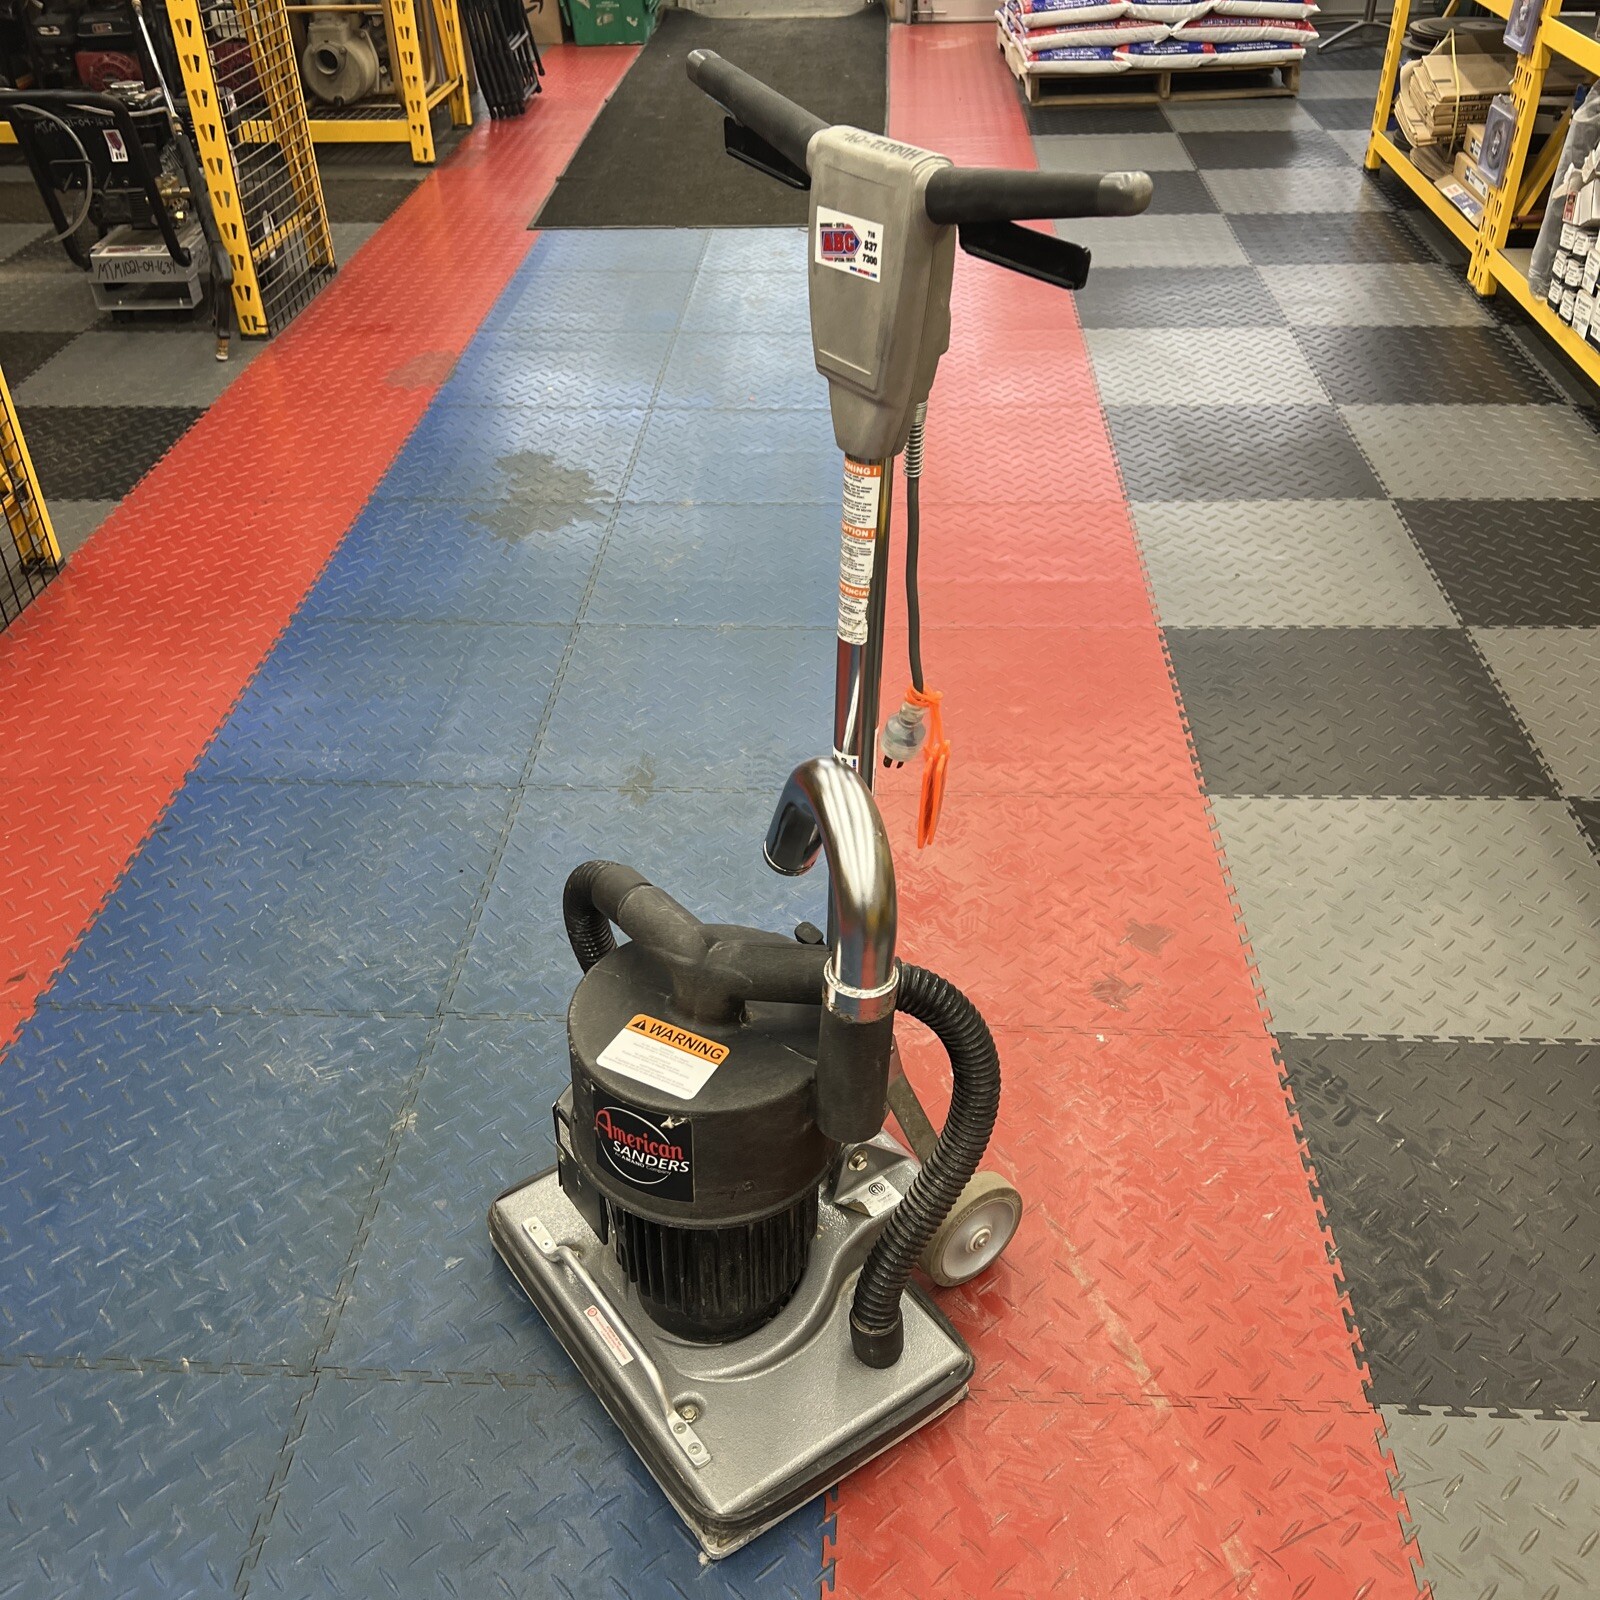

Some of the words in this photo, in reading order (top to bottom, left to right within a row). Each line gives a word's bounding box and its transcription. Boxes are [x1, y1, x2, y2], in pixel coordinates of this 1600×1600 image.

[822, 231, 856, 253] ABC
[864, 240, 878, 252] 837
[862, 253, 878, 266] 7300
[649, 1023, 724, 1060] WARNING
[596, 1109, 684, 1160] American
[613, 1140, 690, 1173] SANDERS
